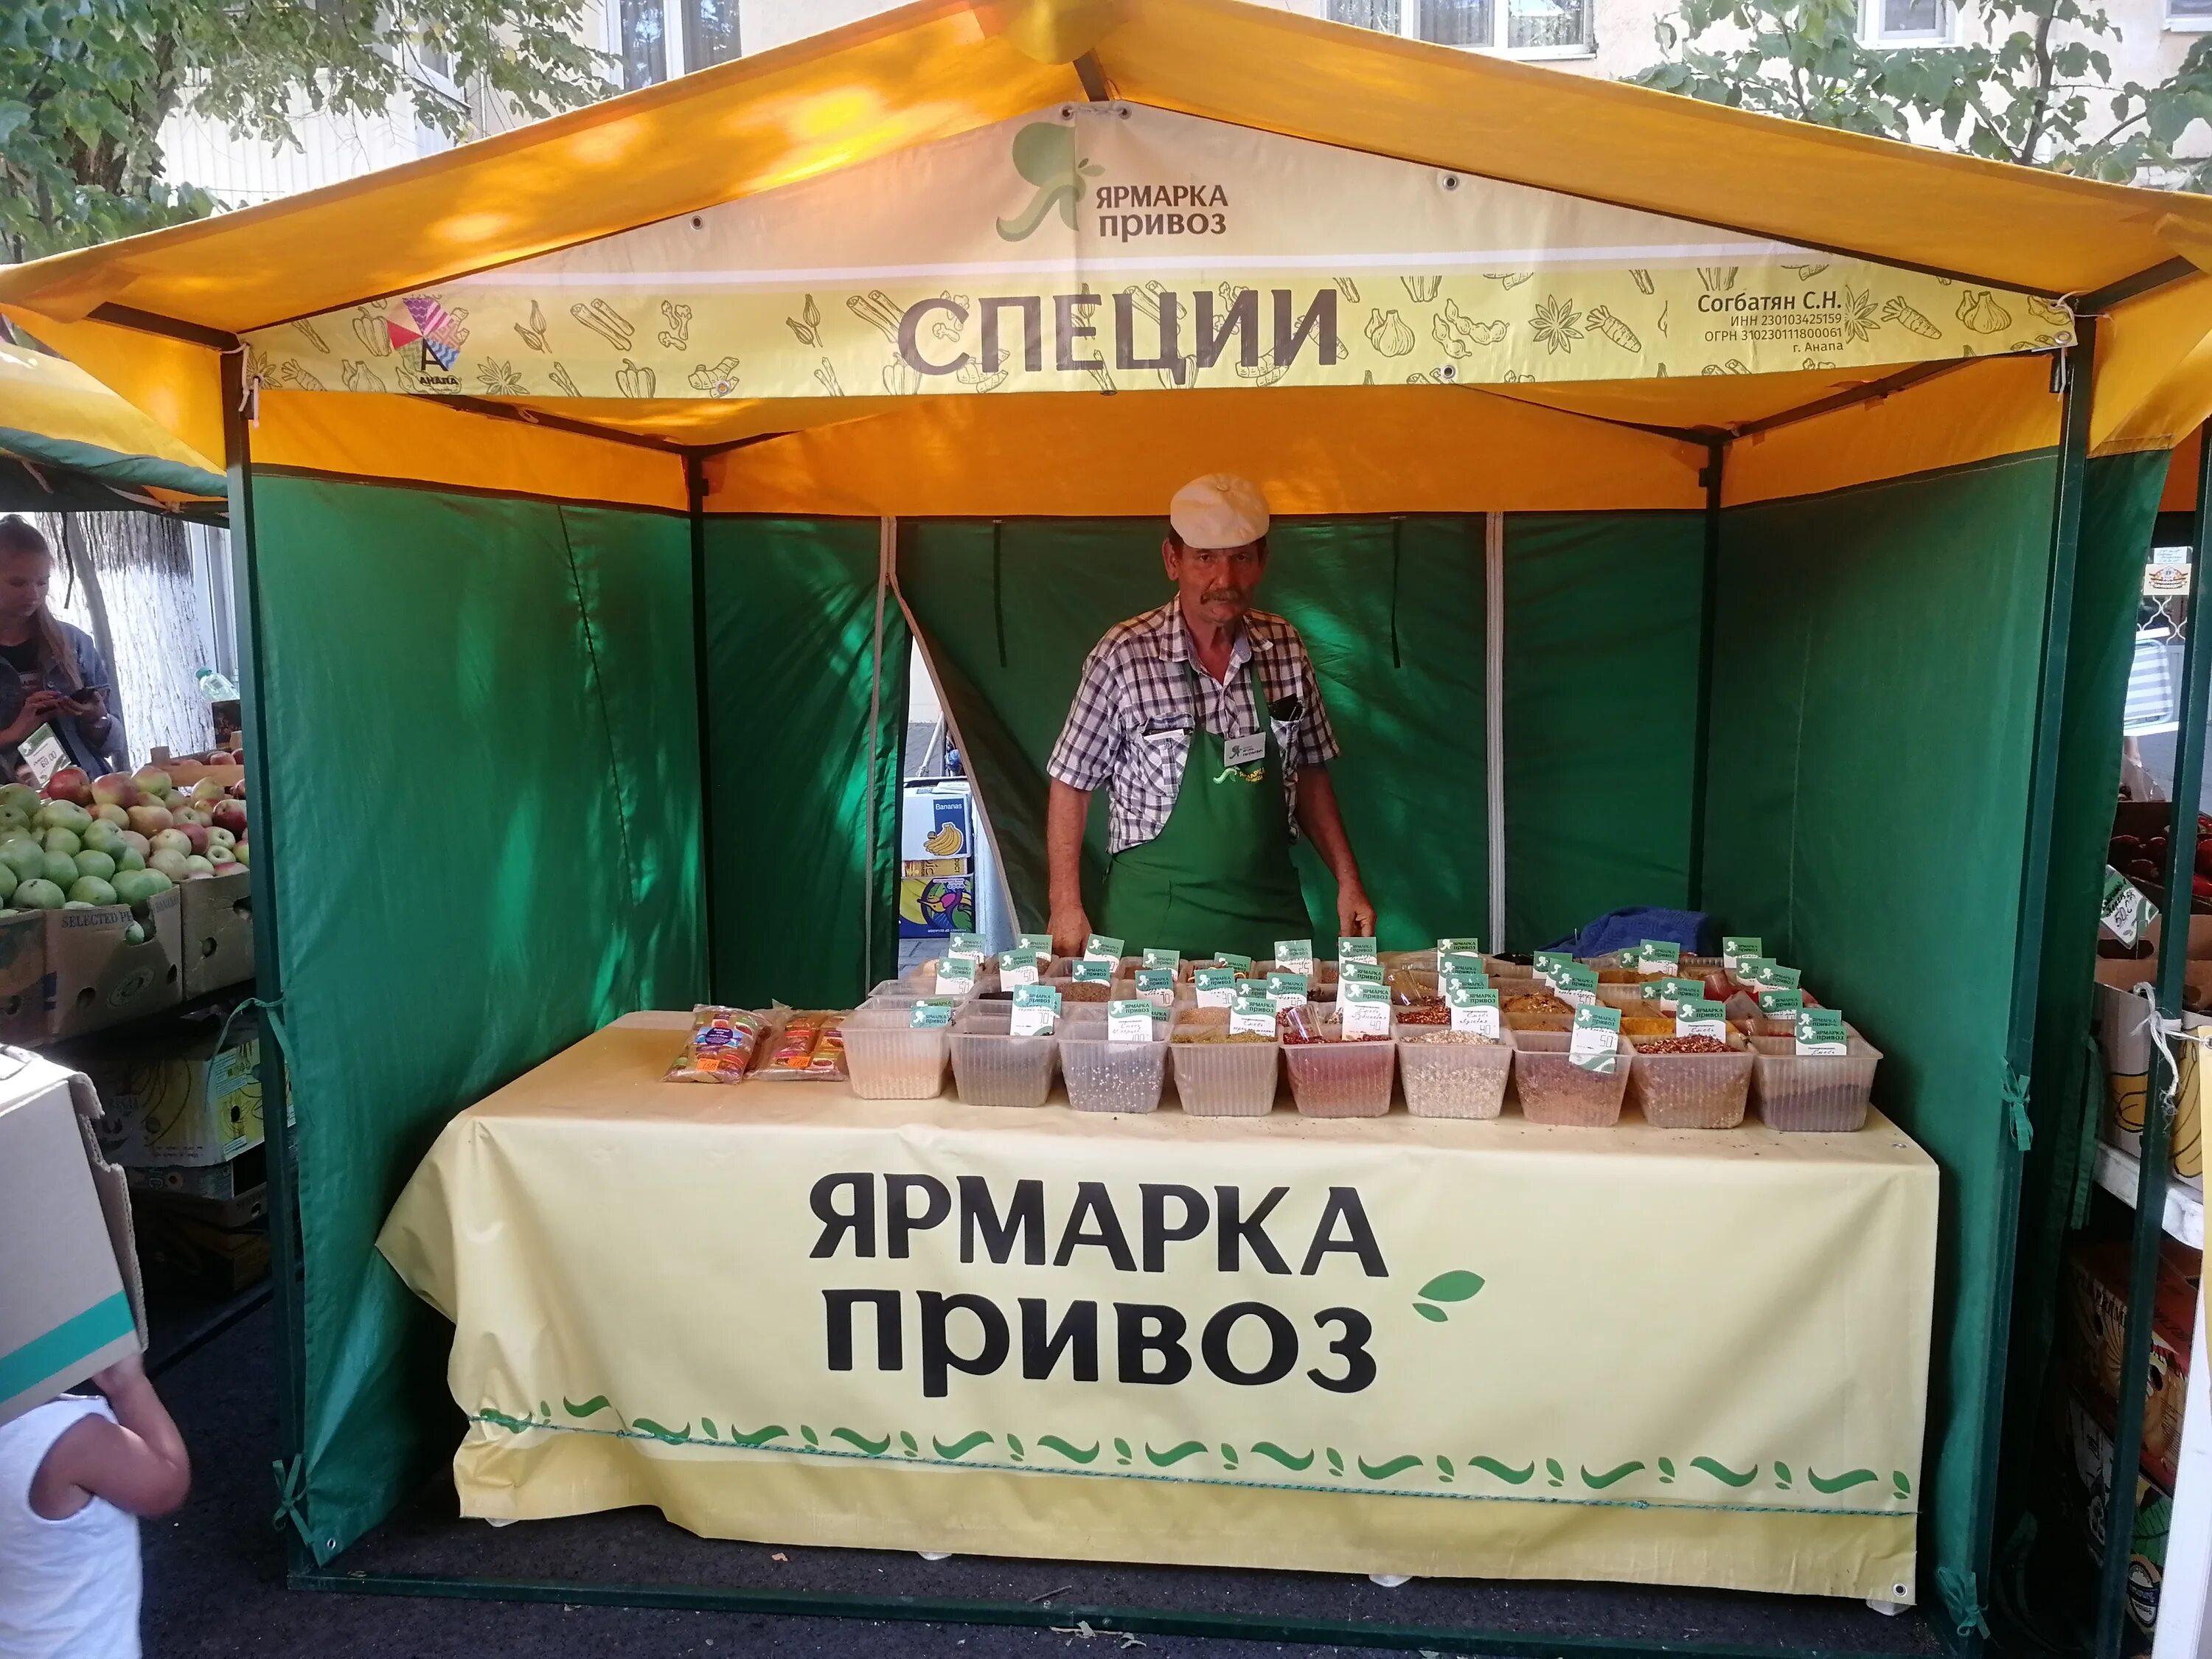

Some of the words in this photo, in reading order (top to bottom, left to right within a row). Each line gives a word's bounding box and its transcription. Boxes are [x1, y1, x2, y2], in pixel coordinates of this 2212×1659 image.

[1096, 184, 1228, 209] ЯРМАРКА
[1698, 292, 1795, 313] Согбатян
[1803, 291, 1842, 310] С.Н.
[1731, 316, 1758, 327] ИНН
[1761, 313, 1842, 326] 230103425159
[898, 289, 1337, 385] СПЕЦИИ
[1705, 330, 1737, 342] ОГРН
[1741, 328, 1842, 341] 310230111800061
[1793, 344, 1801, 352] г.
[1805, 342, 1843, 352] Анапа
[420, 377, 459, 385] АНАПА
[61, 912, 119, 928] SELECTED
[1370, 1020, 1381, 1030] 40
[1479, 1025, 1490, 1034] 40
[1599, 1034, 1613, 1048] 50
[809, 1171, 1390, 1279] ЯРМАРКА
